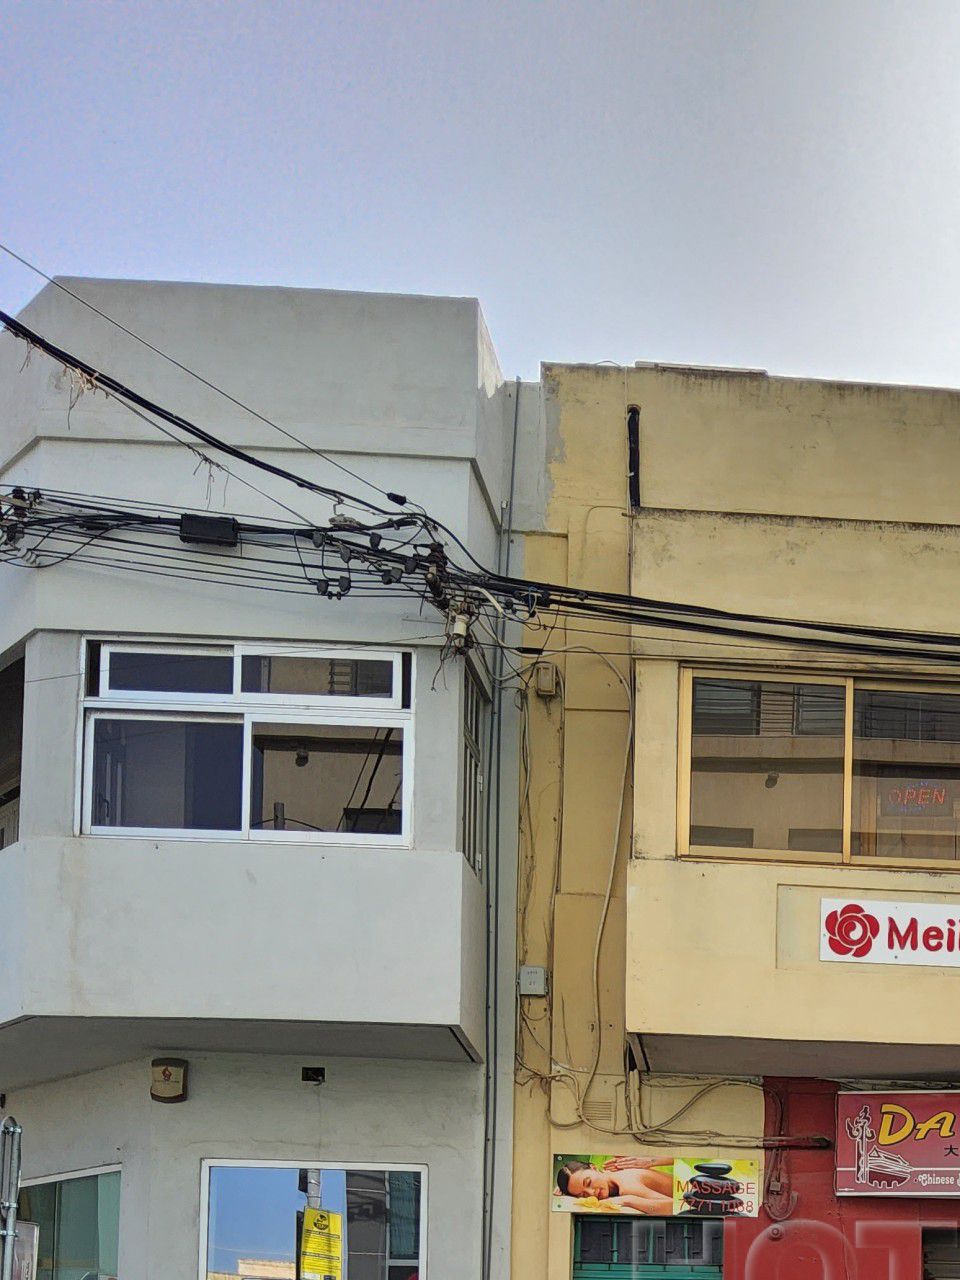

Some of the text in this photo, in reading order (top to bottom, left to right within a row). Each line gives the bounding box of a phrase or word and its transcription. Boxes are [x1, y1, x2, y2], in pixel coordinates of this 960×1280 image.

[888, 787, 946, 805] OPEN
[878, 1103, 956, 1146] DA
[918, 1172, 955, 1185] Chinese
[676, 1180, 756, 1195] MASSAGE
[678, 1198, 754, 1213] 7771 1088
